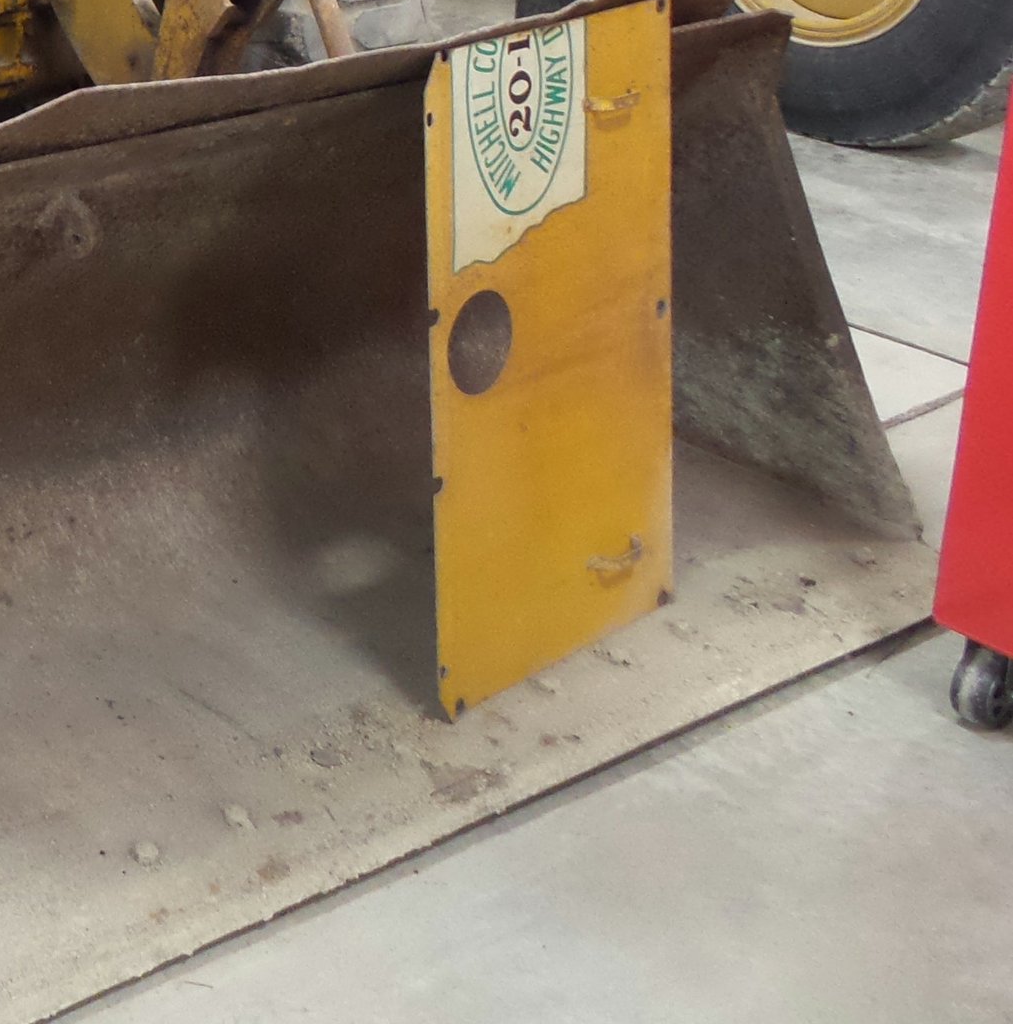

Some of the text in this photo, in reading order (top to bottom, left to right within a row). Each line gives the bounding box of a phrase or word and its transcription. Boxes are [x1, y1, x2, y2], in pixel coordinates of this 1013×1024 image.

[472, 80, 521, 201] MITCHELL
[507, 34, 533, 138] 20-1
[530, 55, 568, 174] HIGHWAY
